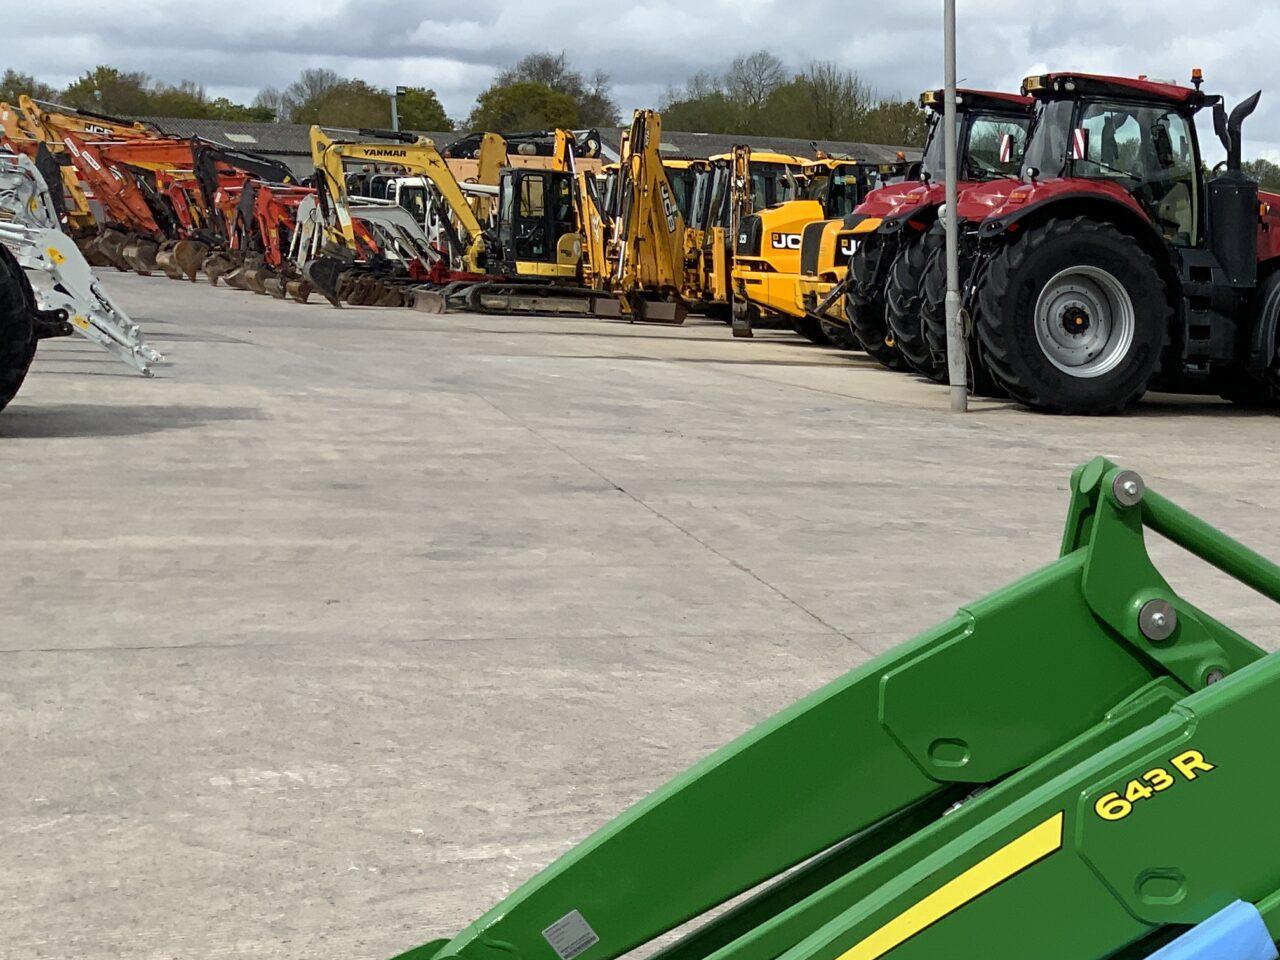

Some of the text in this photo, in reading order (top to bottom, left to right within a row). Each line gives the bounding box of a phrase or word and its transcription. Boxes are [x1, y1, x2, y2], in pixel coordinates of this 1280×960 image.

[363, 149, 407, 157] YANMAR
[660, 183, 676, 233] JCB
[772, 233, 802, 250] JC
[1094, 749, 1218, 821] 643 R
